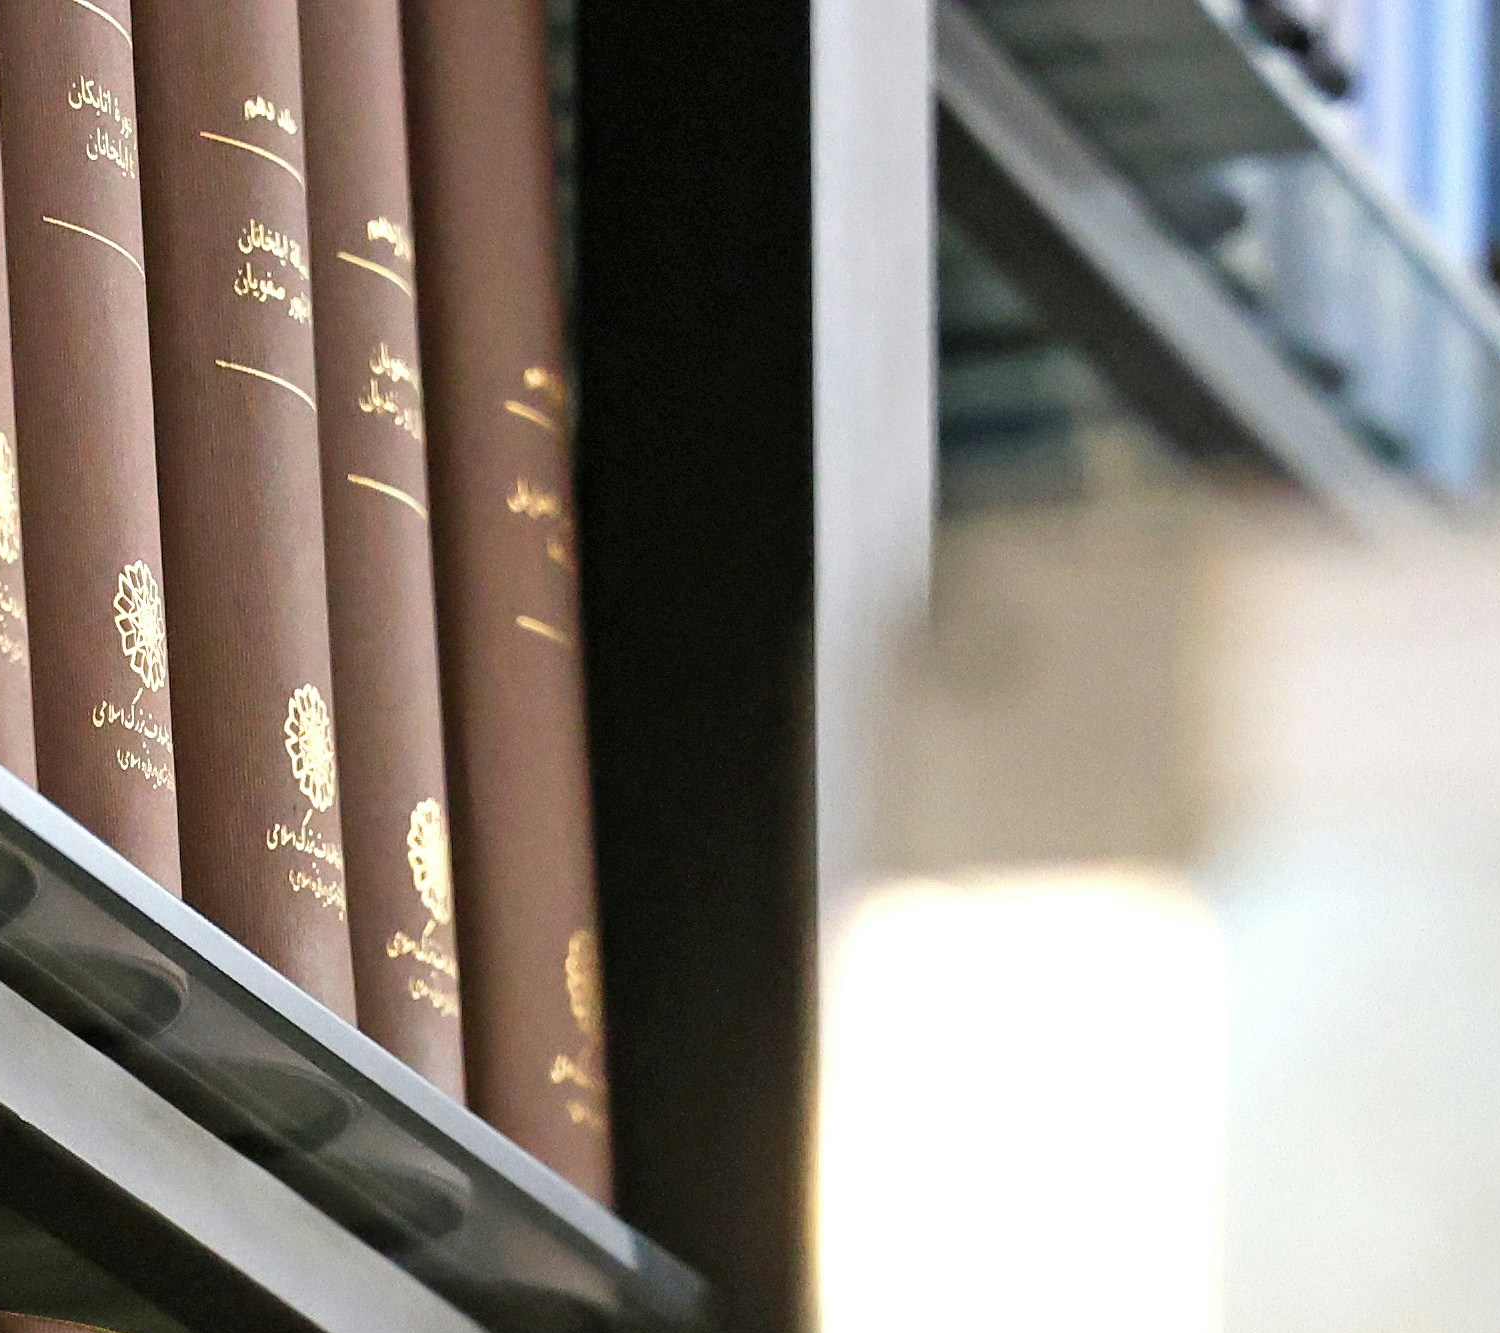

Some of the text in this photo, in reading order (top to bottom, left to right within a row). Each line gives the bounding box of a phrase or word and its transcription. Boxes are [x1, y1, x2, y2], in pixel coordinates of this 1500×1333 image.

[233, 261, 286, 302] صفویان
[92, 700, 125, 728] اسلامی
[266, 823, 297, 851] اسلامی
